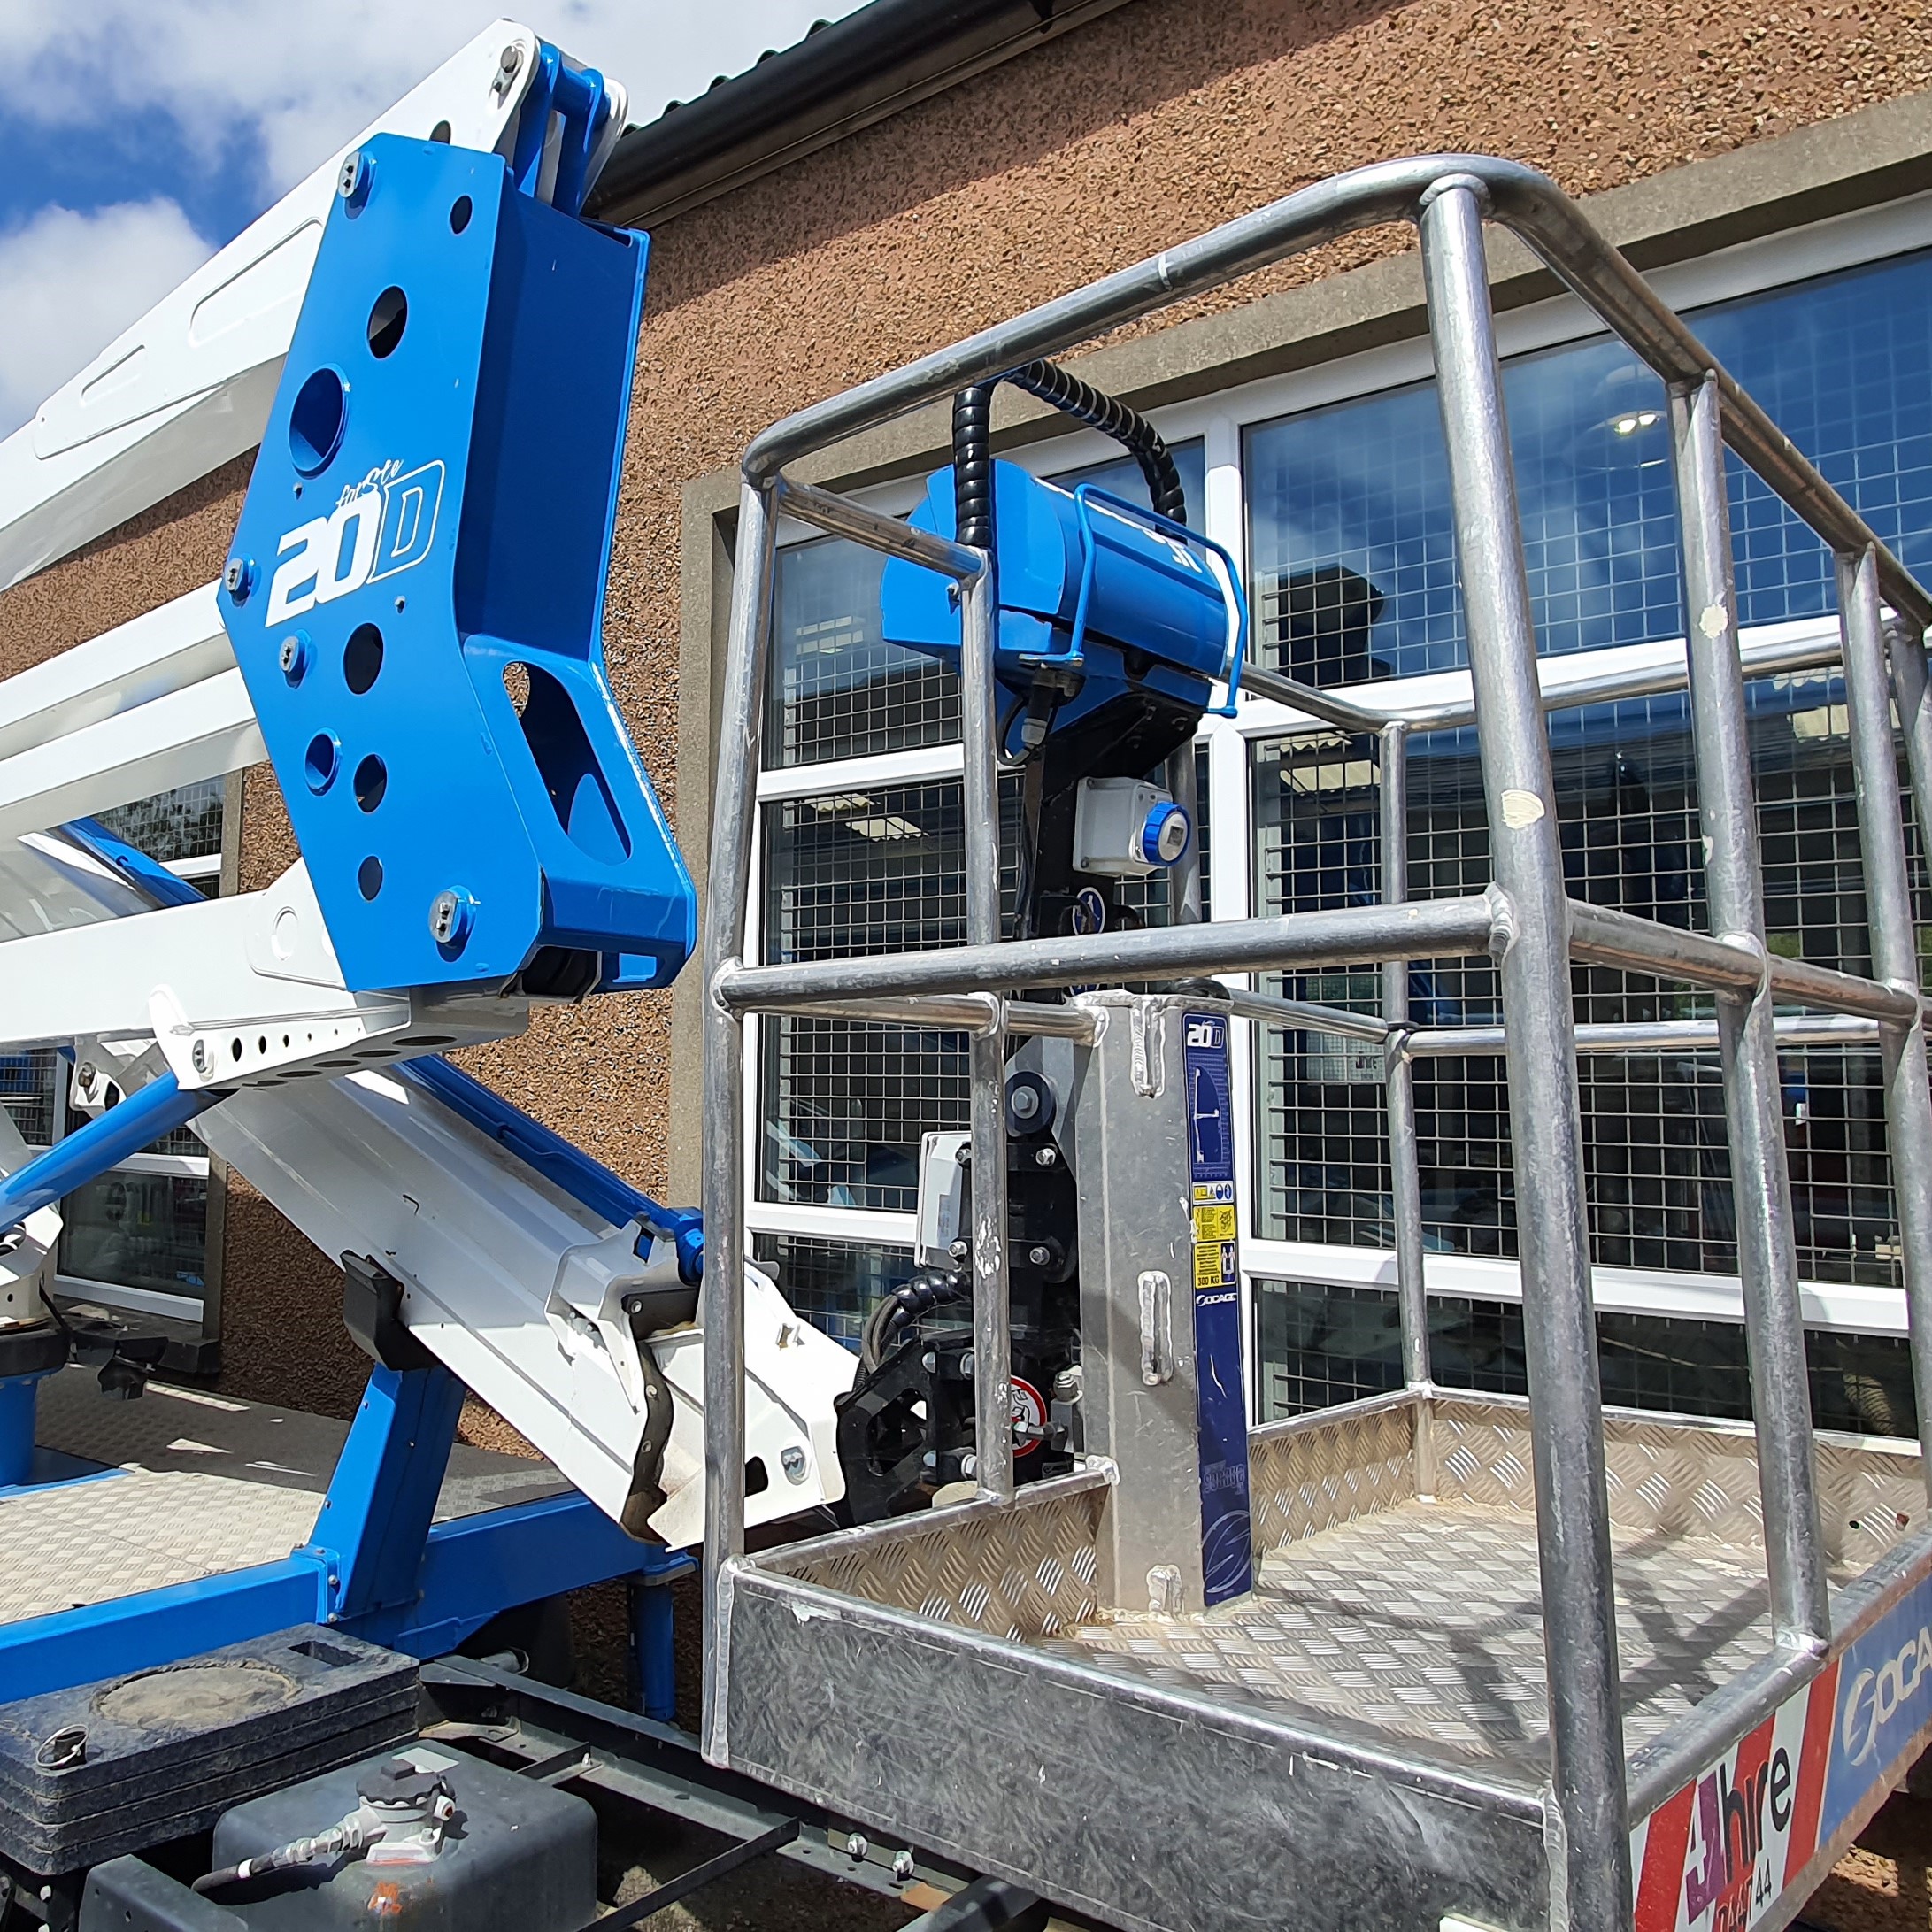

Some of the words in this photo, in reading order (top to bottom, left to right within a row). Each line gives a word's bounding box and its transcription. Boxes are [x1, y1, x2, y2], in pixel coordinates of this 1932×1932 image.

[265, 459, 445, 627] 20D
[1187, 1022, 1225, 1049] 20D
[1197, 1276, 1209, 1287] 300
[1196, 1292, 1237, 1307] SOCAGE
